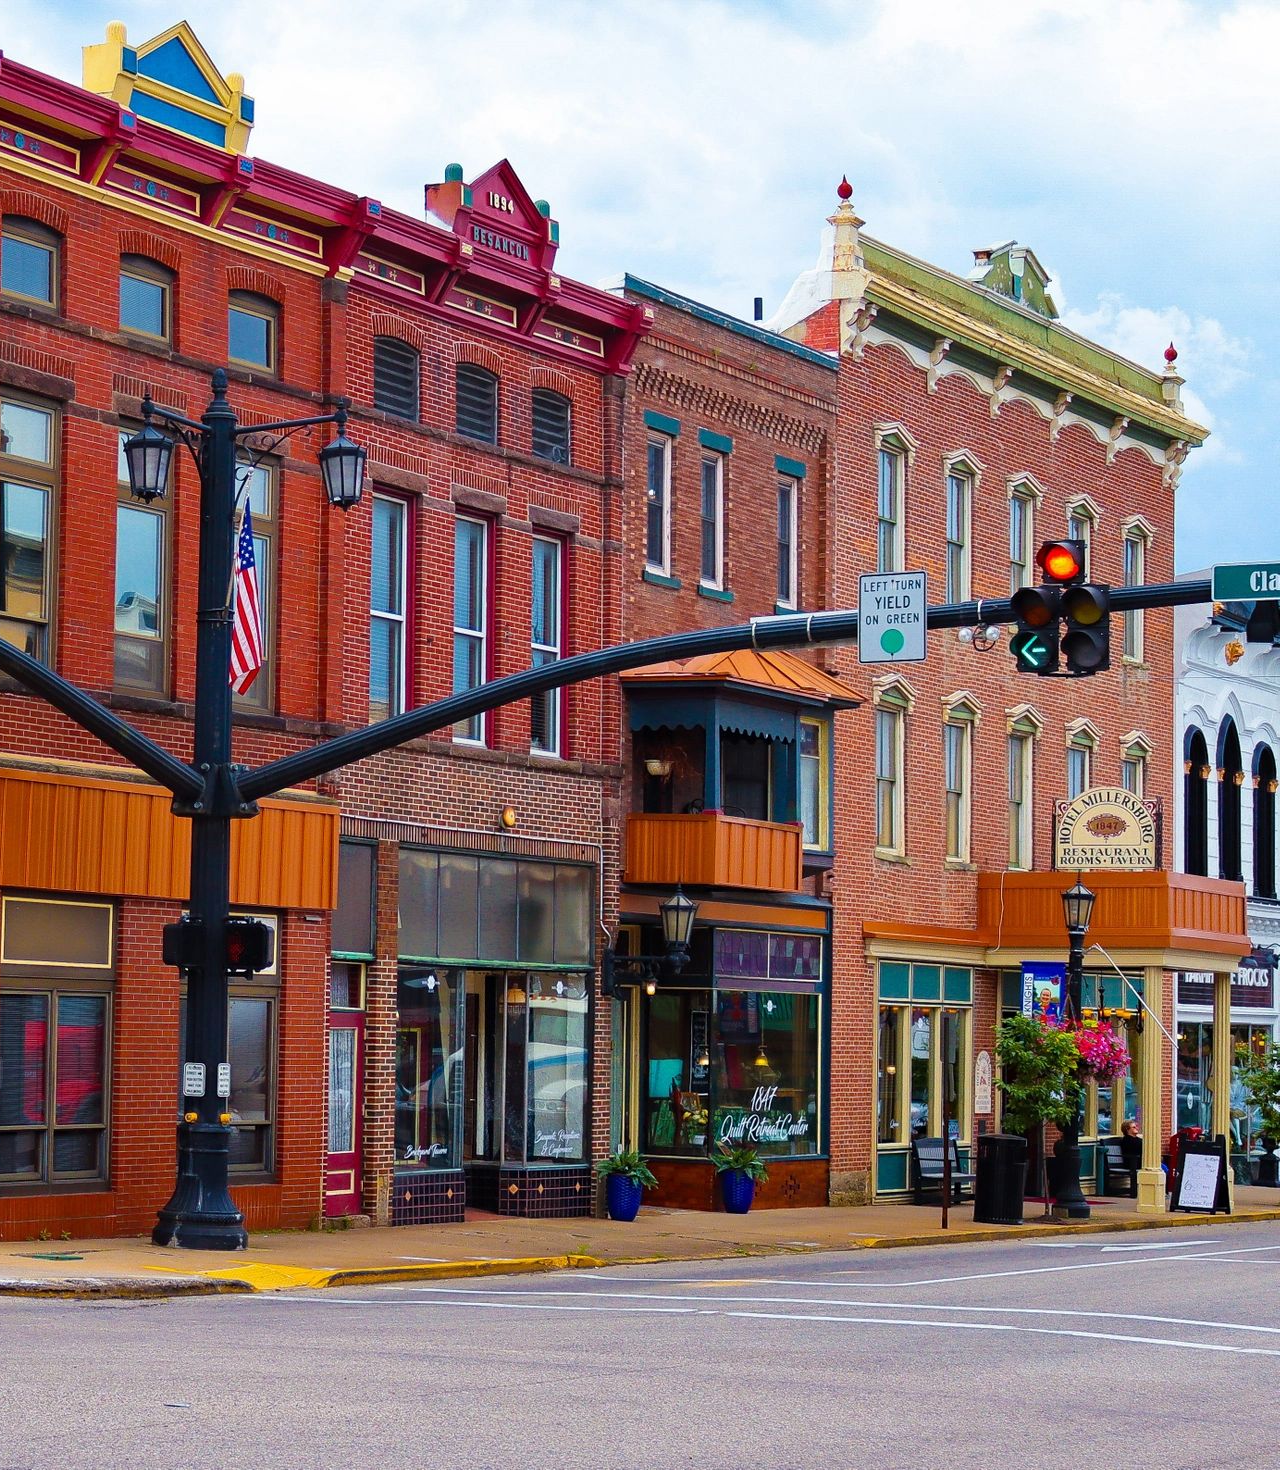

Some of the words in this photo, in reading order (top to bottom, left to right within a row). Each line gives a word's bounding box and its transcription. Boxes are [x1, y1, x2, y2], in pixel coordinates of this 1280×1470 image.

[488, 191, 514, 214] 1894
[472, 225, 528, 261] BESANCON
[863, 581, 888, 592] LEFT
[895, 579, 921, 590] TURN
[874, 595, 911, 609] YIELD
[865, 615, 879, 625] ON
[886, 613, 920, 624] GREEN
[1059, 807, 1082, 845] HOTEL
[1081, 791, 1154, 844] MILLERSBURG
[1095, 821, 1119, 831] 1847
[1060, 856, 1101, 865] ROOMS
[1110, 856, 1153, 865] TAVERN
[1063, 847, 1150, 857] RESTAURANT
[1023, 976, 1032, 1013] KNIGHTS
[750, 1086, 779, 1112] 1847
[721, 1114, 748, 1145] Quilt
[746, 1114, 783, 1142] Retreat
[780, 1113, 809, 1140] Center
